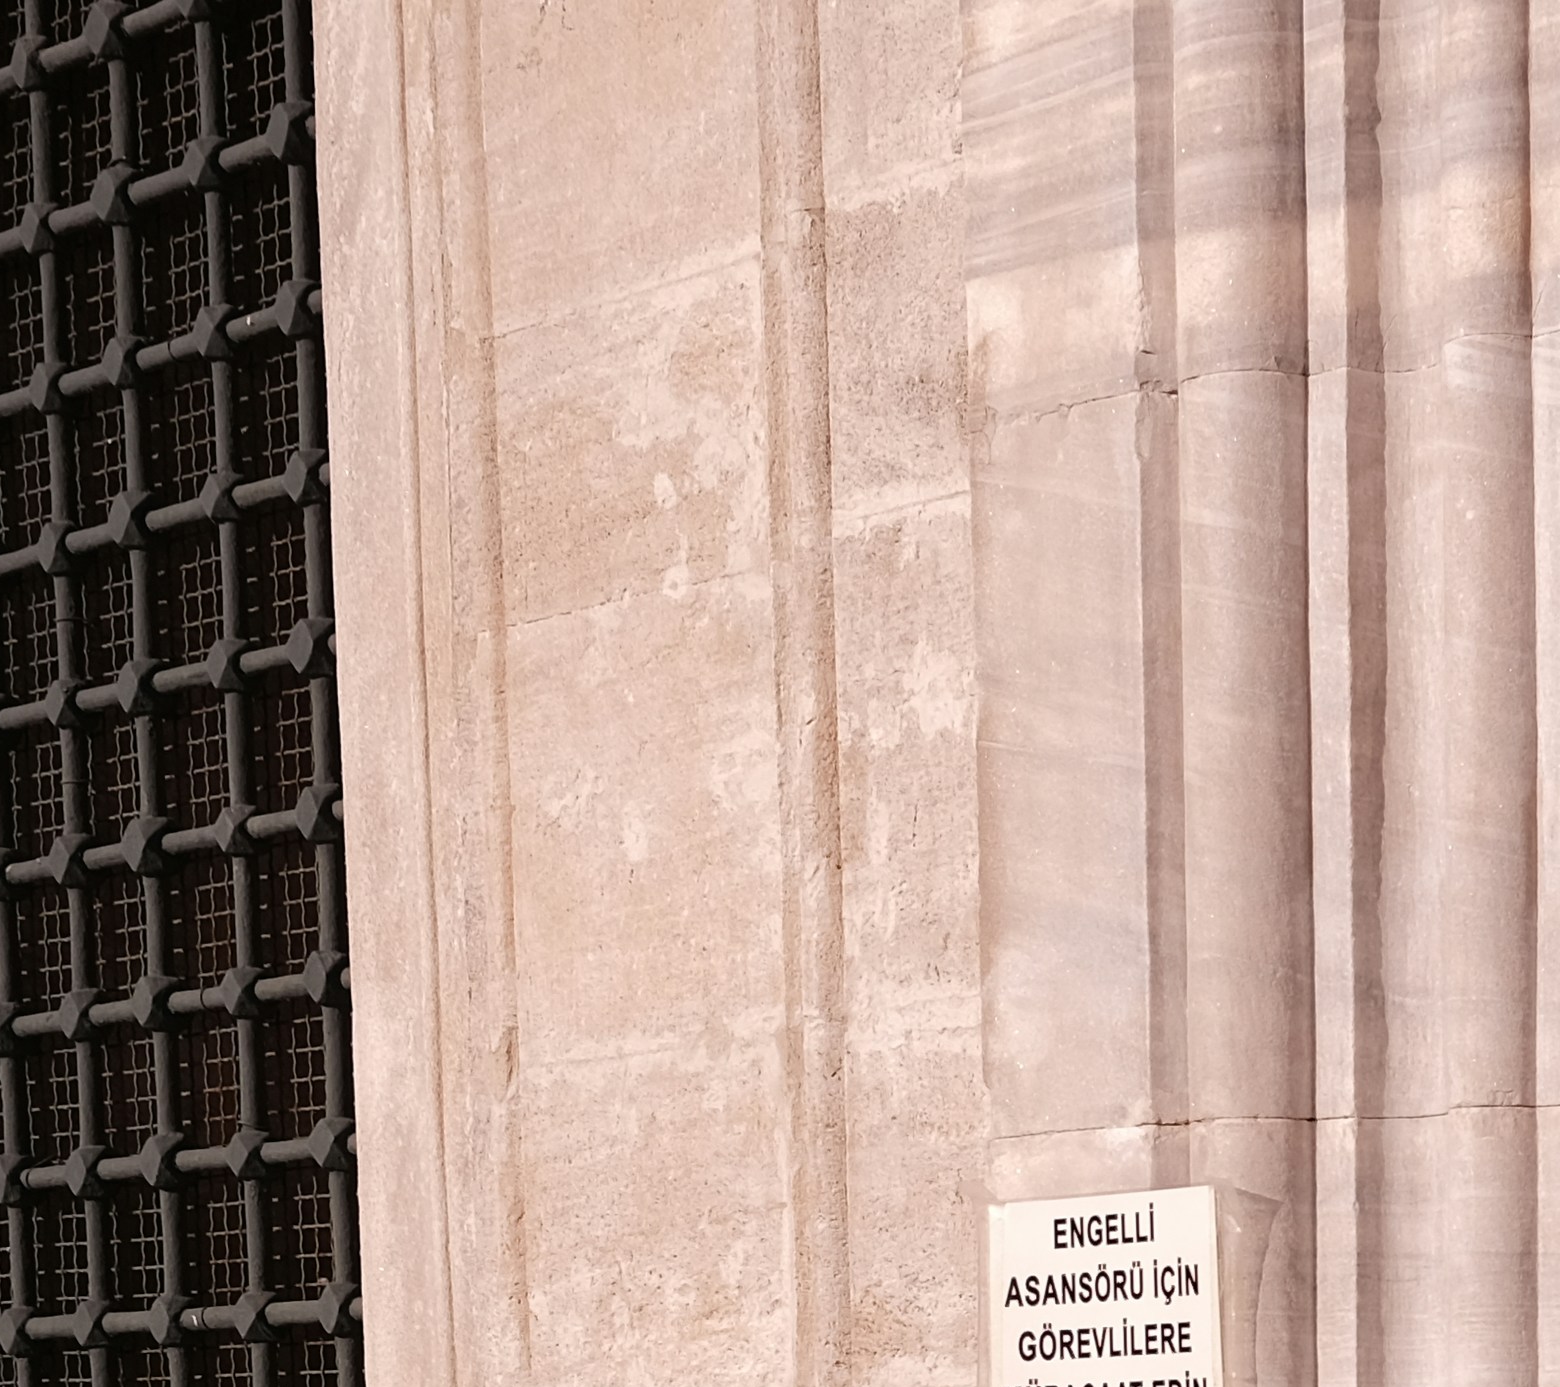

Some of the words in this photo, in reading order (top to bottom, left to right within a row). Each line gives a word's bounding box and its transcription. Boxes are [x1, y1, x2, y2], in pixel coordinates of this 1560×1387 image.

[1053, 1202, 1154, 1249] ENGELLİ
[1004, 1261, 1144, 1307] ASANSÖRÜ
[1153, 1257, 1199, 1305] İÇİN
[1018, 1318, 1192, 1361] GÖREVLİLERE
